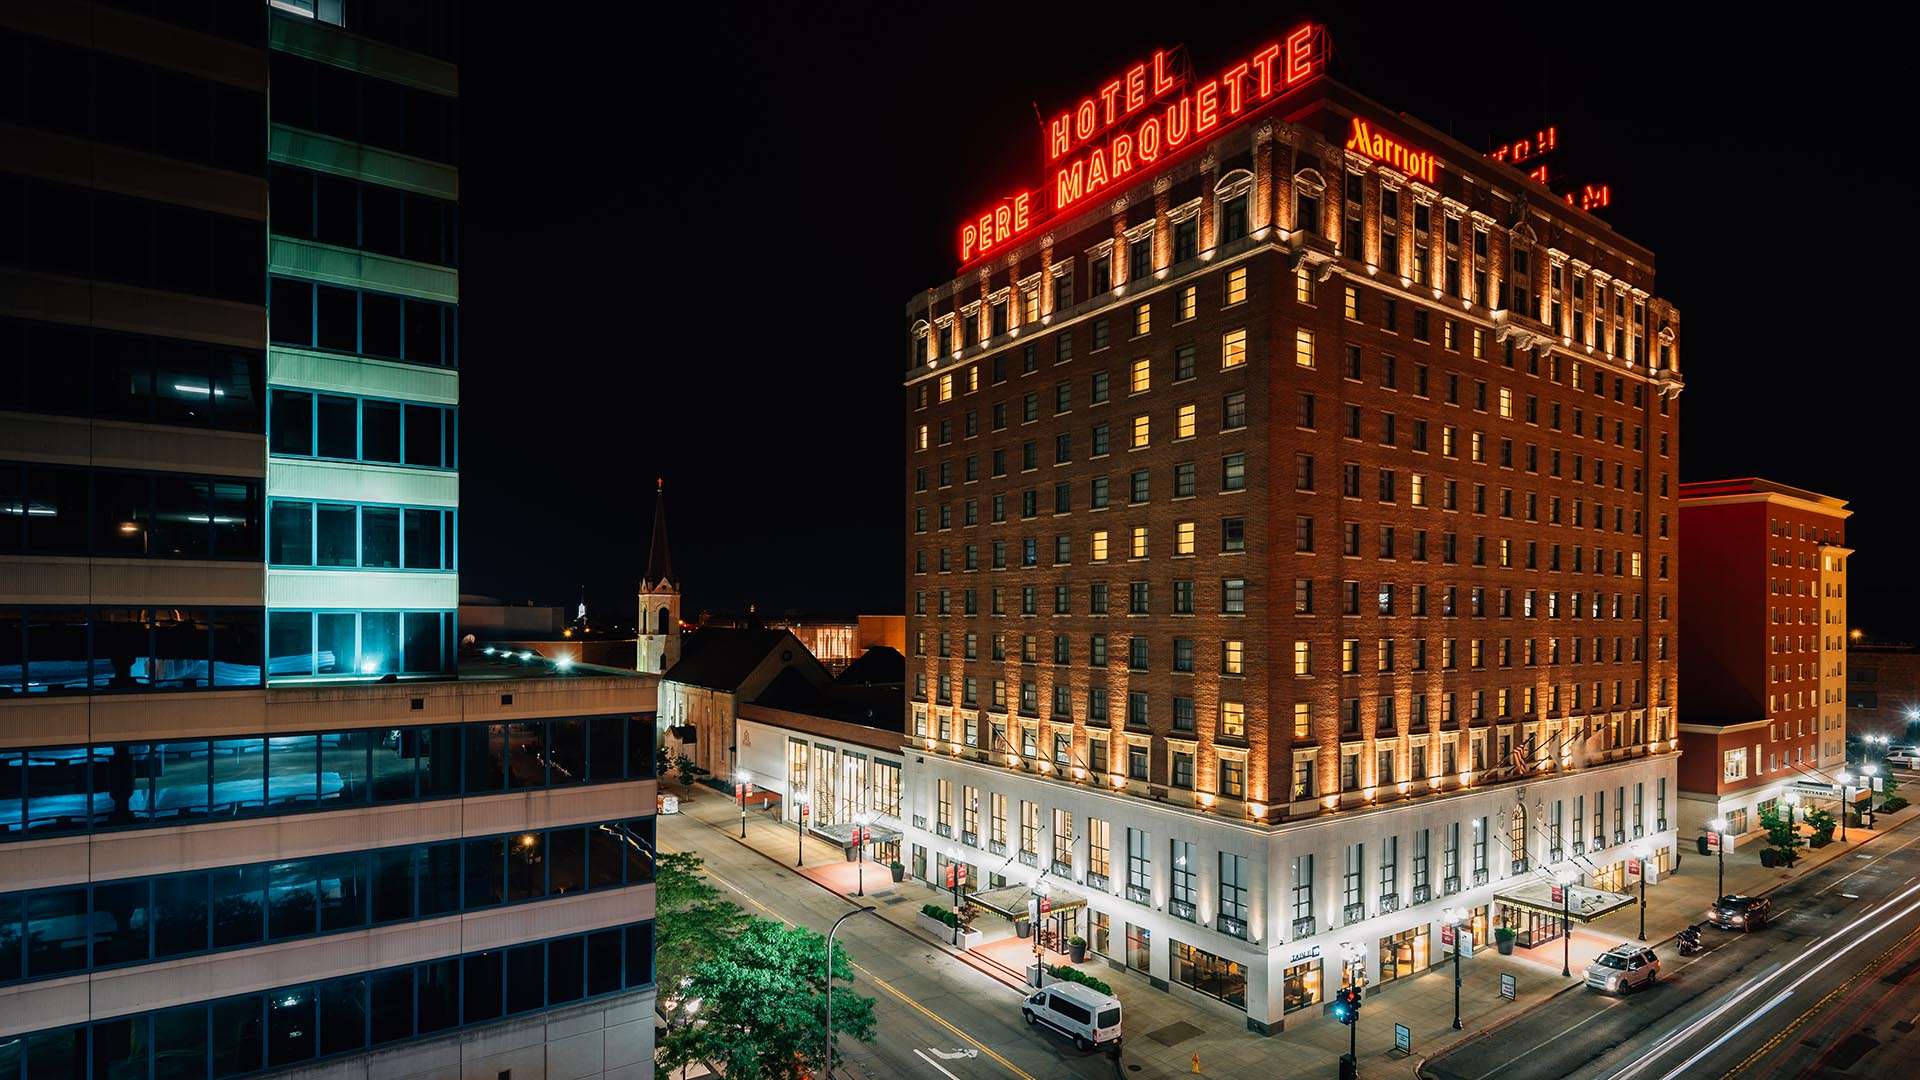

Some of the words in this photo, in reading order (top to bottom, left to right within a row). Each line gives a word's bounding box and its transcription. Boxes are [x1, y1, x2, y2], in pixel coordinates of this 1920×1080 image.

[962, 192, 1030, 261] PERE
[1056, 25, 1312, 209] MARQUETTE
[1051, 50, 1174, 159] HOTEL
[1346, 117, 1435, 183] Marriott
